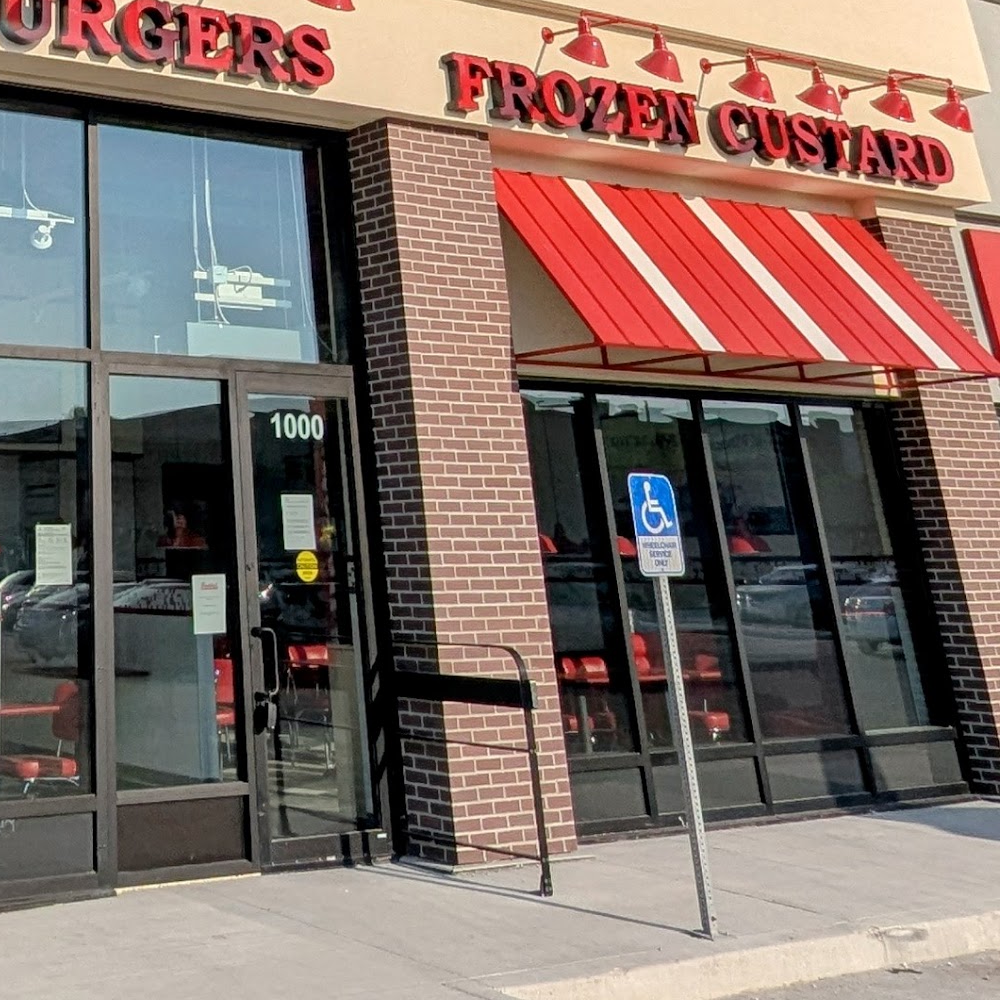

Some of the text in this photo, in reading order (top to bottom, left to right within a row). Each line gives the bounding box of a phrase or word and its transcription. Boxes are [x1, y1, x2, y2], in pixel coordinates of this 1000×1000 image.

[442, 52, 956, 187] FROZEN CUSTARD
[270, 412, 324, 440] 1000
